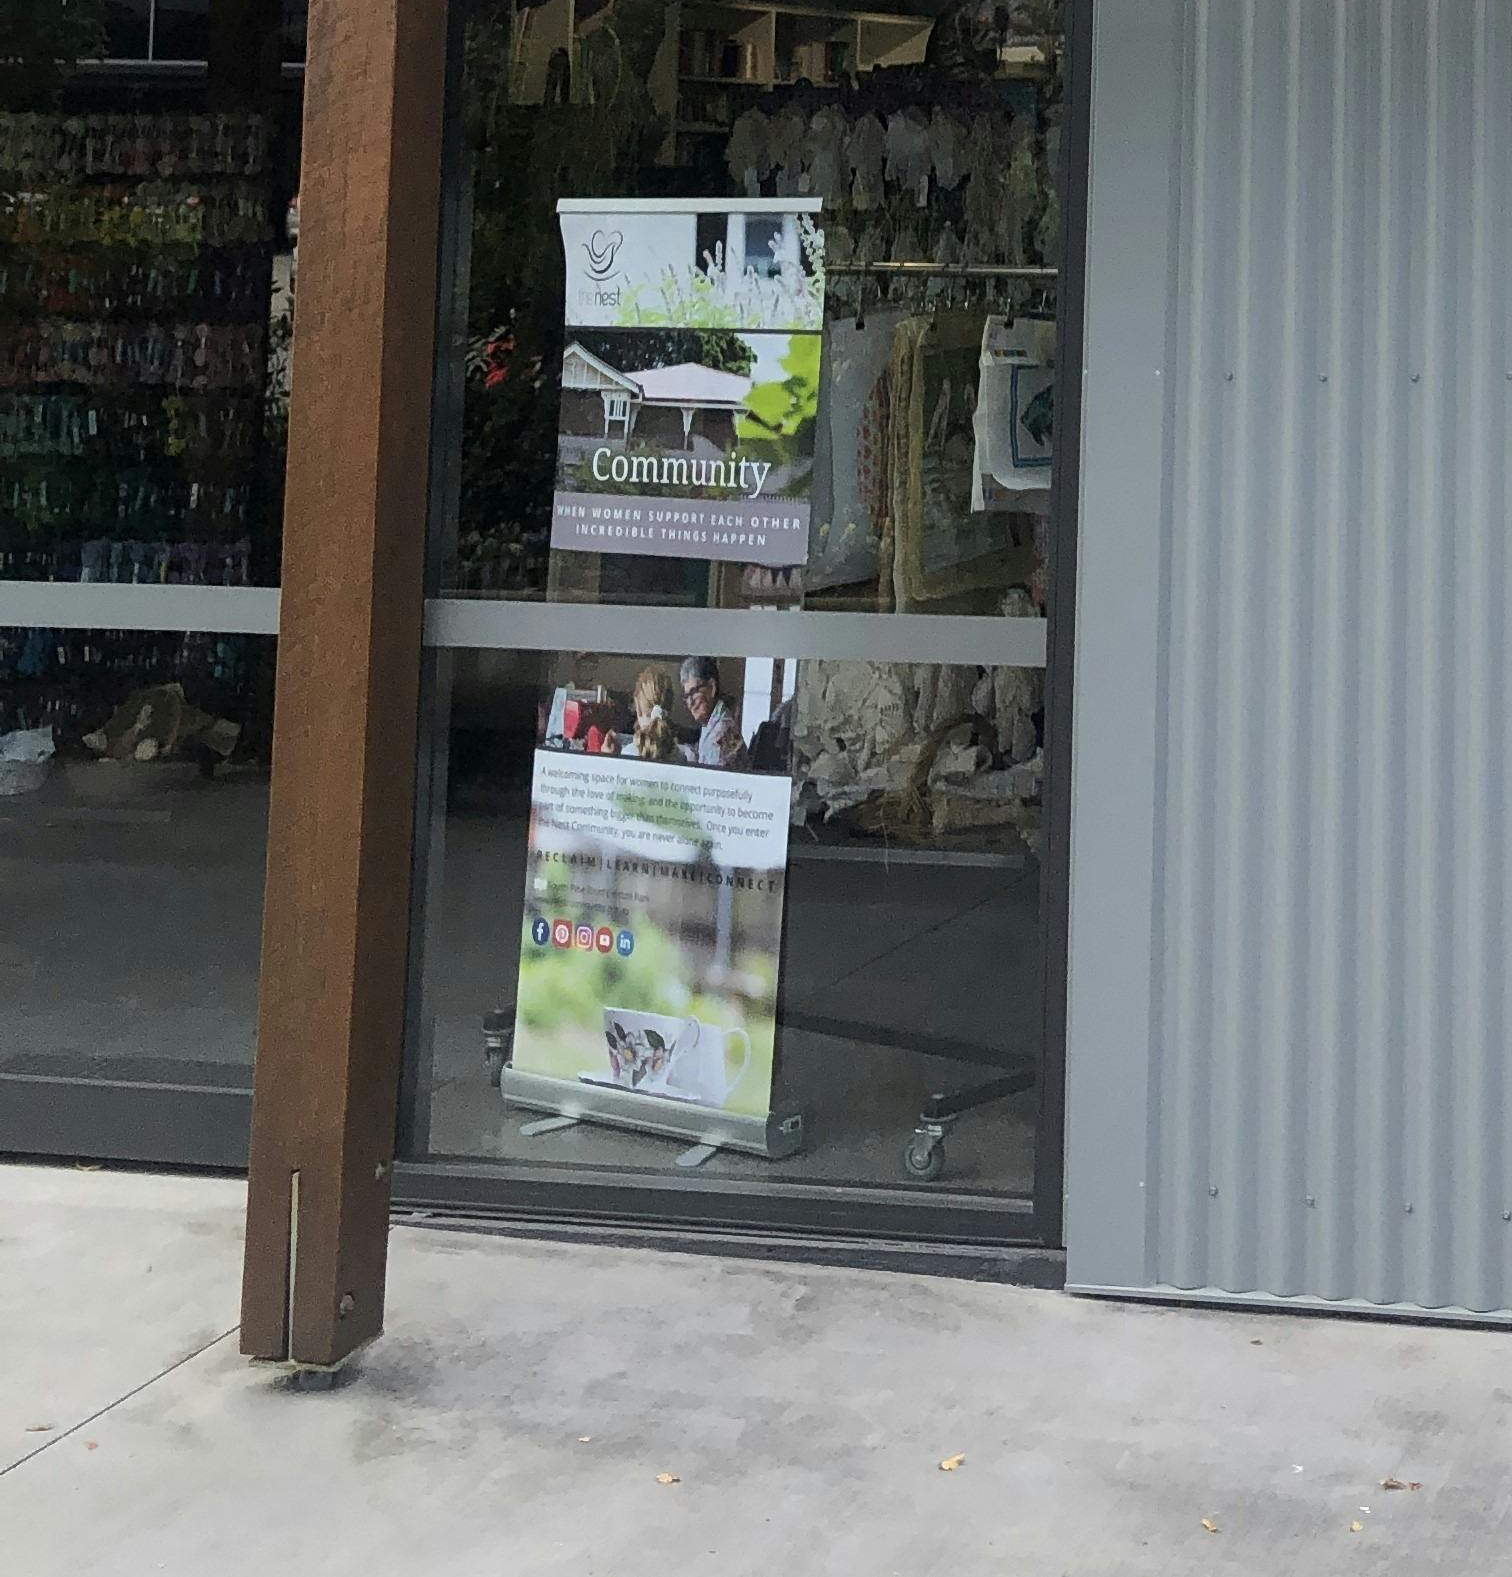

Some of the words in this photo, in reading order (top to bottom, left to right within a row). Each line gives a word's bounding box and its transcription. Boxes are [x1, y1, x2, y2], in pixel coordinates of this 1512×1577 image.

[592, 447, 771, 498] Community
[556, 504, 586, 518] WHEN
[592, 507, 642, 521] WOMEN
[648, 510, 705, 525] SUPPORT
[710, 514, 743, 527] EACH
[750, 516, 801, 530] OTHER
[575, 523, 654, 539] INCREDIBLE
[661, 527, 707, 542] THINGS
[713, 531, 766, 545] HAPPEN
[591, 773, 614, 785] space
[616, 773, 628, 784] for
[586, 788, 604, 800] love
[727, 807, 736, 817] to
[737, 808, 774, 821] become
[706, 820, 727, 834] Once
[727, 825, 744, 837] you
[745, 827, 770, 839] enter
[536, 849, 596, 867] RECLAIM
[606, 858, 649, 875] LEARN
[706, 871, 775, 894] CONNECT
